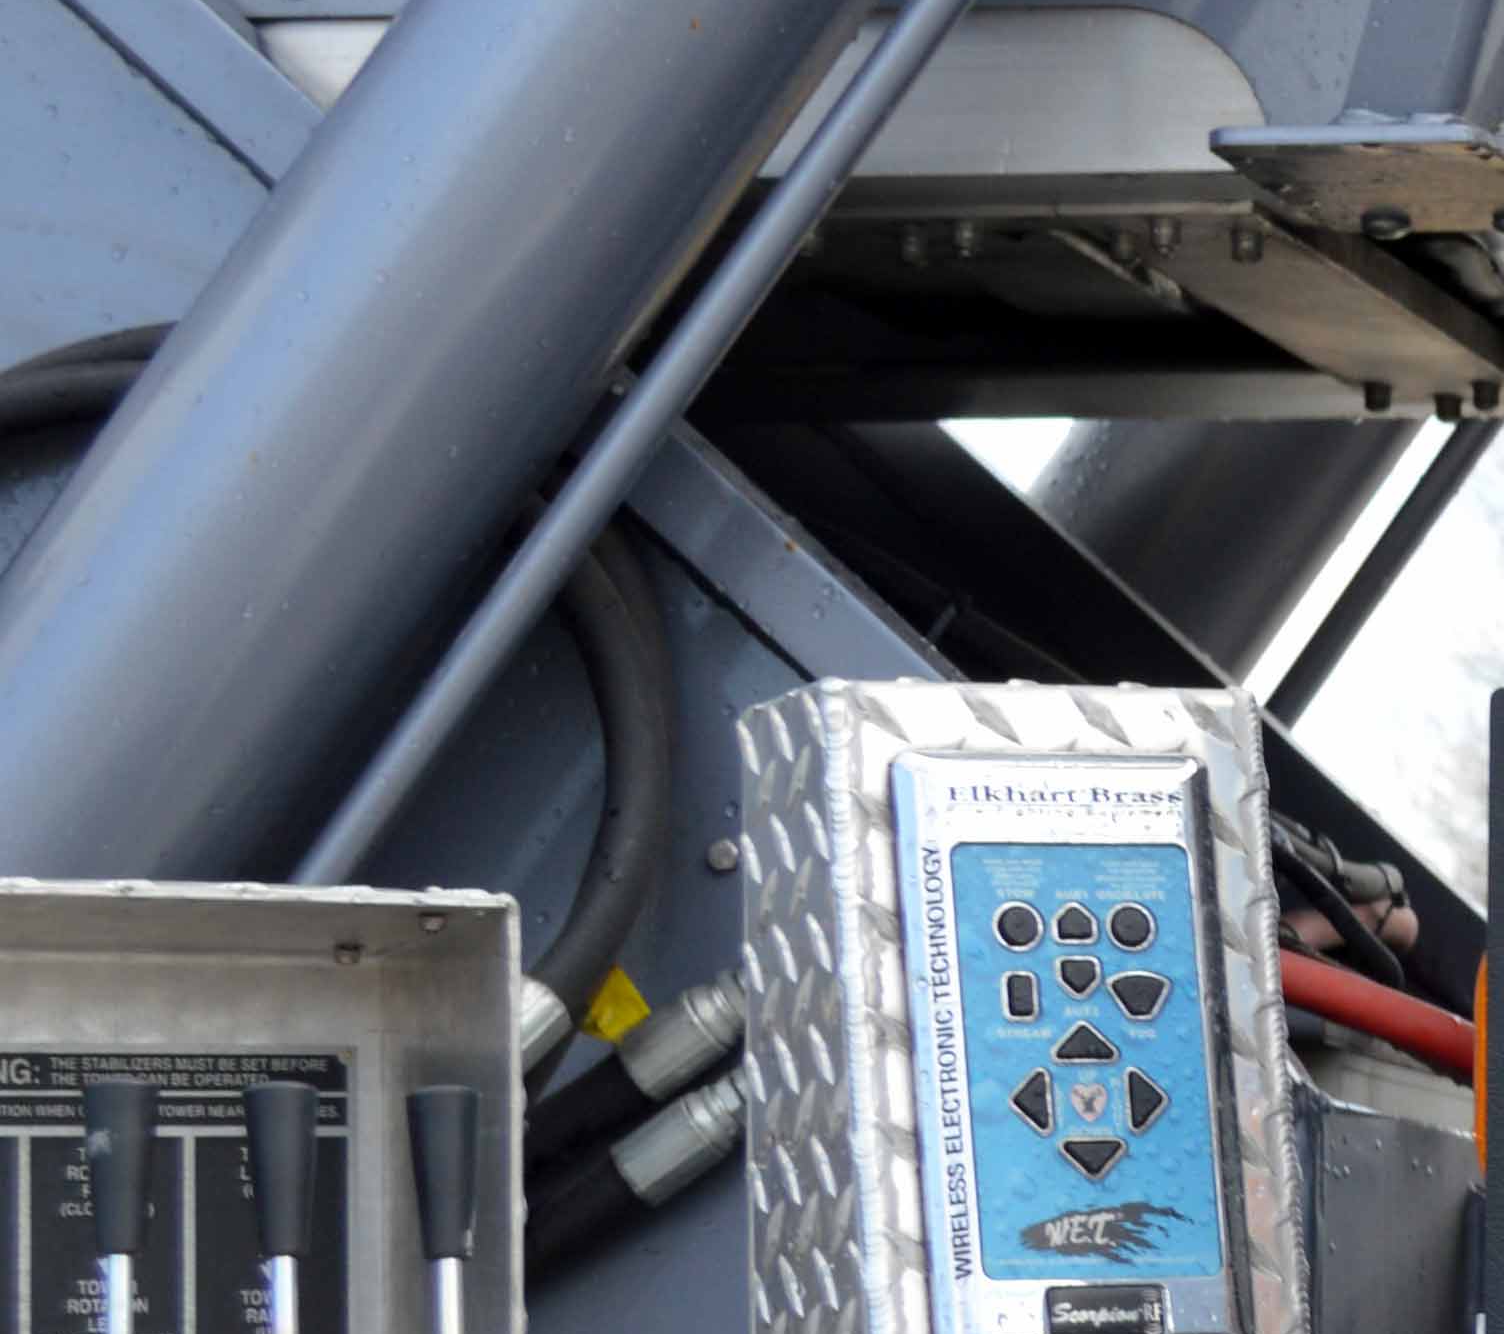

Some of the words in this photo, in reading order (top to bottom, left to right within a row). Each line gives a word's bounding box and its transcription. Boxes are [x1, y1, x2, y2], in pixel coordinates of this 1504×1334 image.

[947, 784, 1077, 804] Elkhart
[1090, 786, 1185, 805] Brass
[921, 847, 953, 1002] TECHNOLOGY
[51, 1056, 78, 1071] THE
[81, 1056, 171, 1071] STABILIZERS
[177, 1056, 216, 1071] MUST
[219, 1056, 239, 1071] BE
[244, 1056, 269, 1071] SET
[274, 1057, 329, 1072] BEFORE
[51, 1072, 78, 1086] THE
[171, 1073, 189, 1086] BE
[936, 1009, 968, 1156] ELECTRONIC
[158, 1104, 201, 1118] TOWER
[948, 1162, 974, 1281] WIRELESS
[1051, 1302, 1139, 1328] Scorpion
